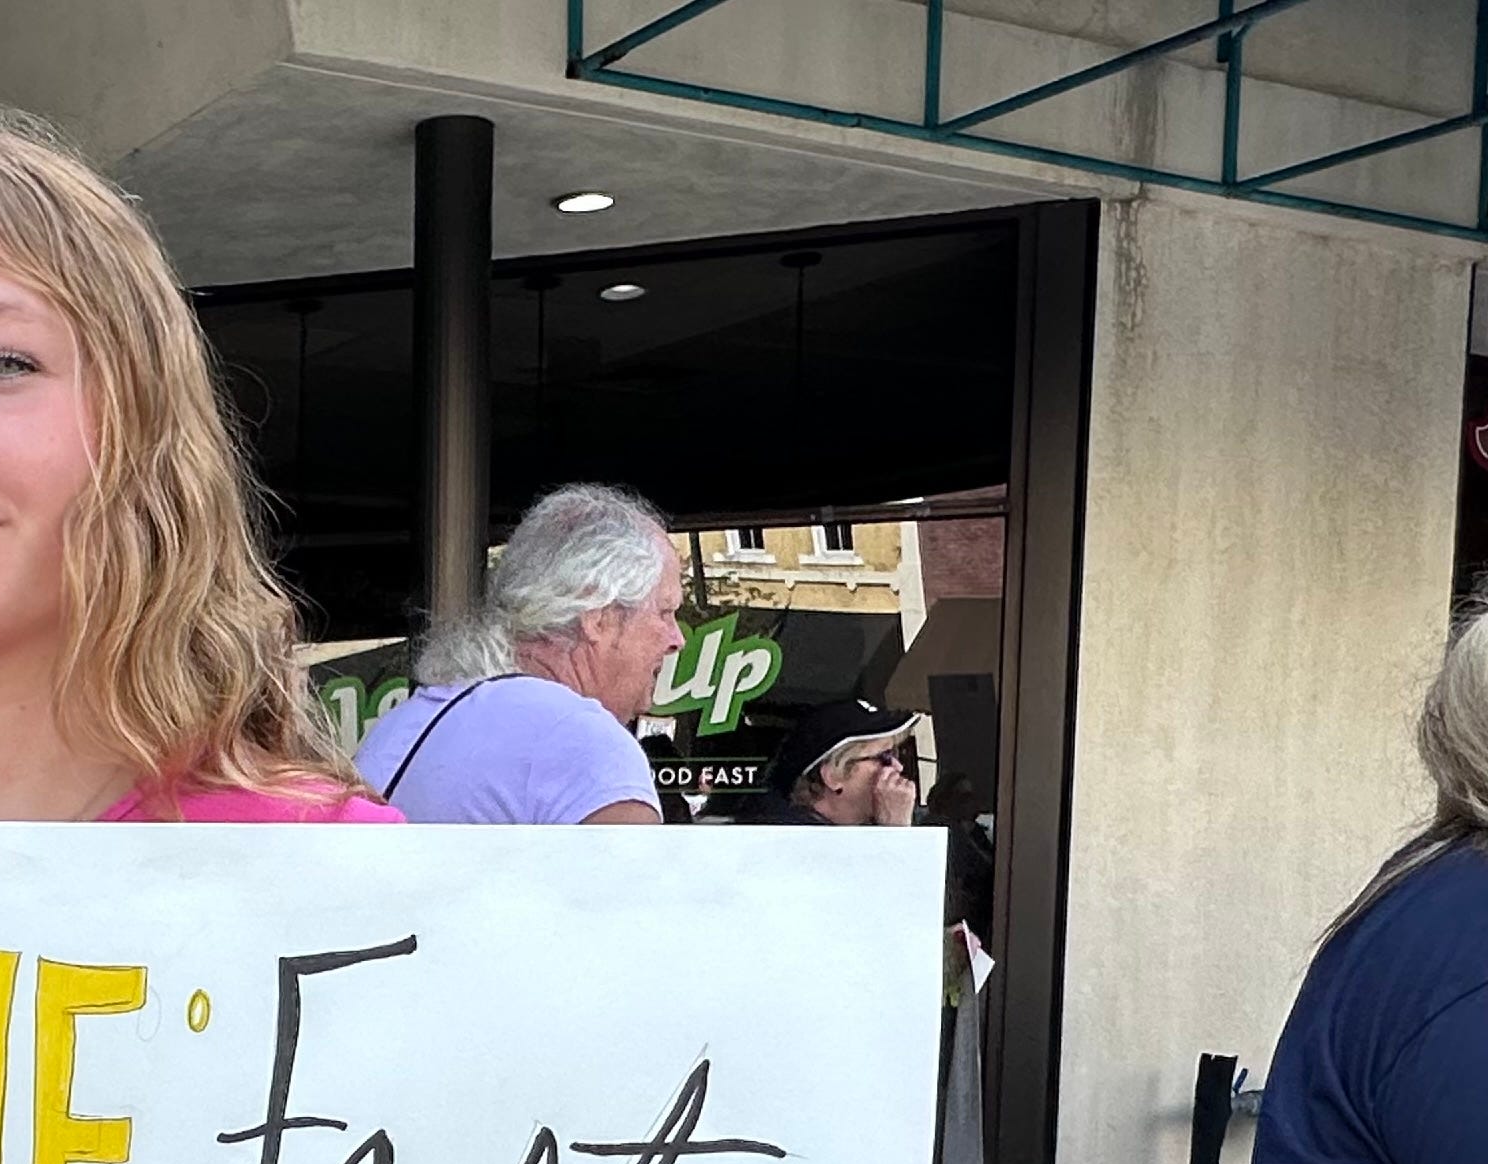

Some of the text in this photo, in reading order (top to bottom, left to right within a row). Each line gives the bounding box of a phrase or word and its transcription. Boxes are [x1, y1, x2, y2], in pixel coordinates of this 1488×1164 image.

[653, 629, 771, 724] Up
[652, 766, 758, 785] OD FAST
